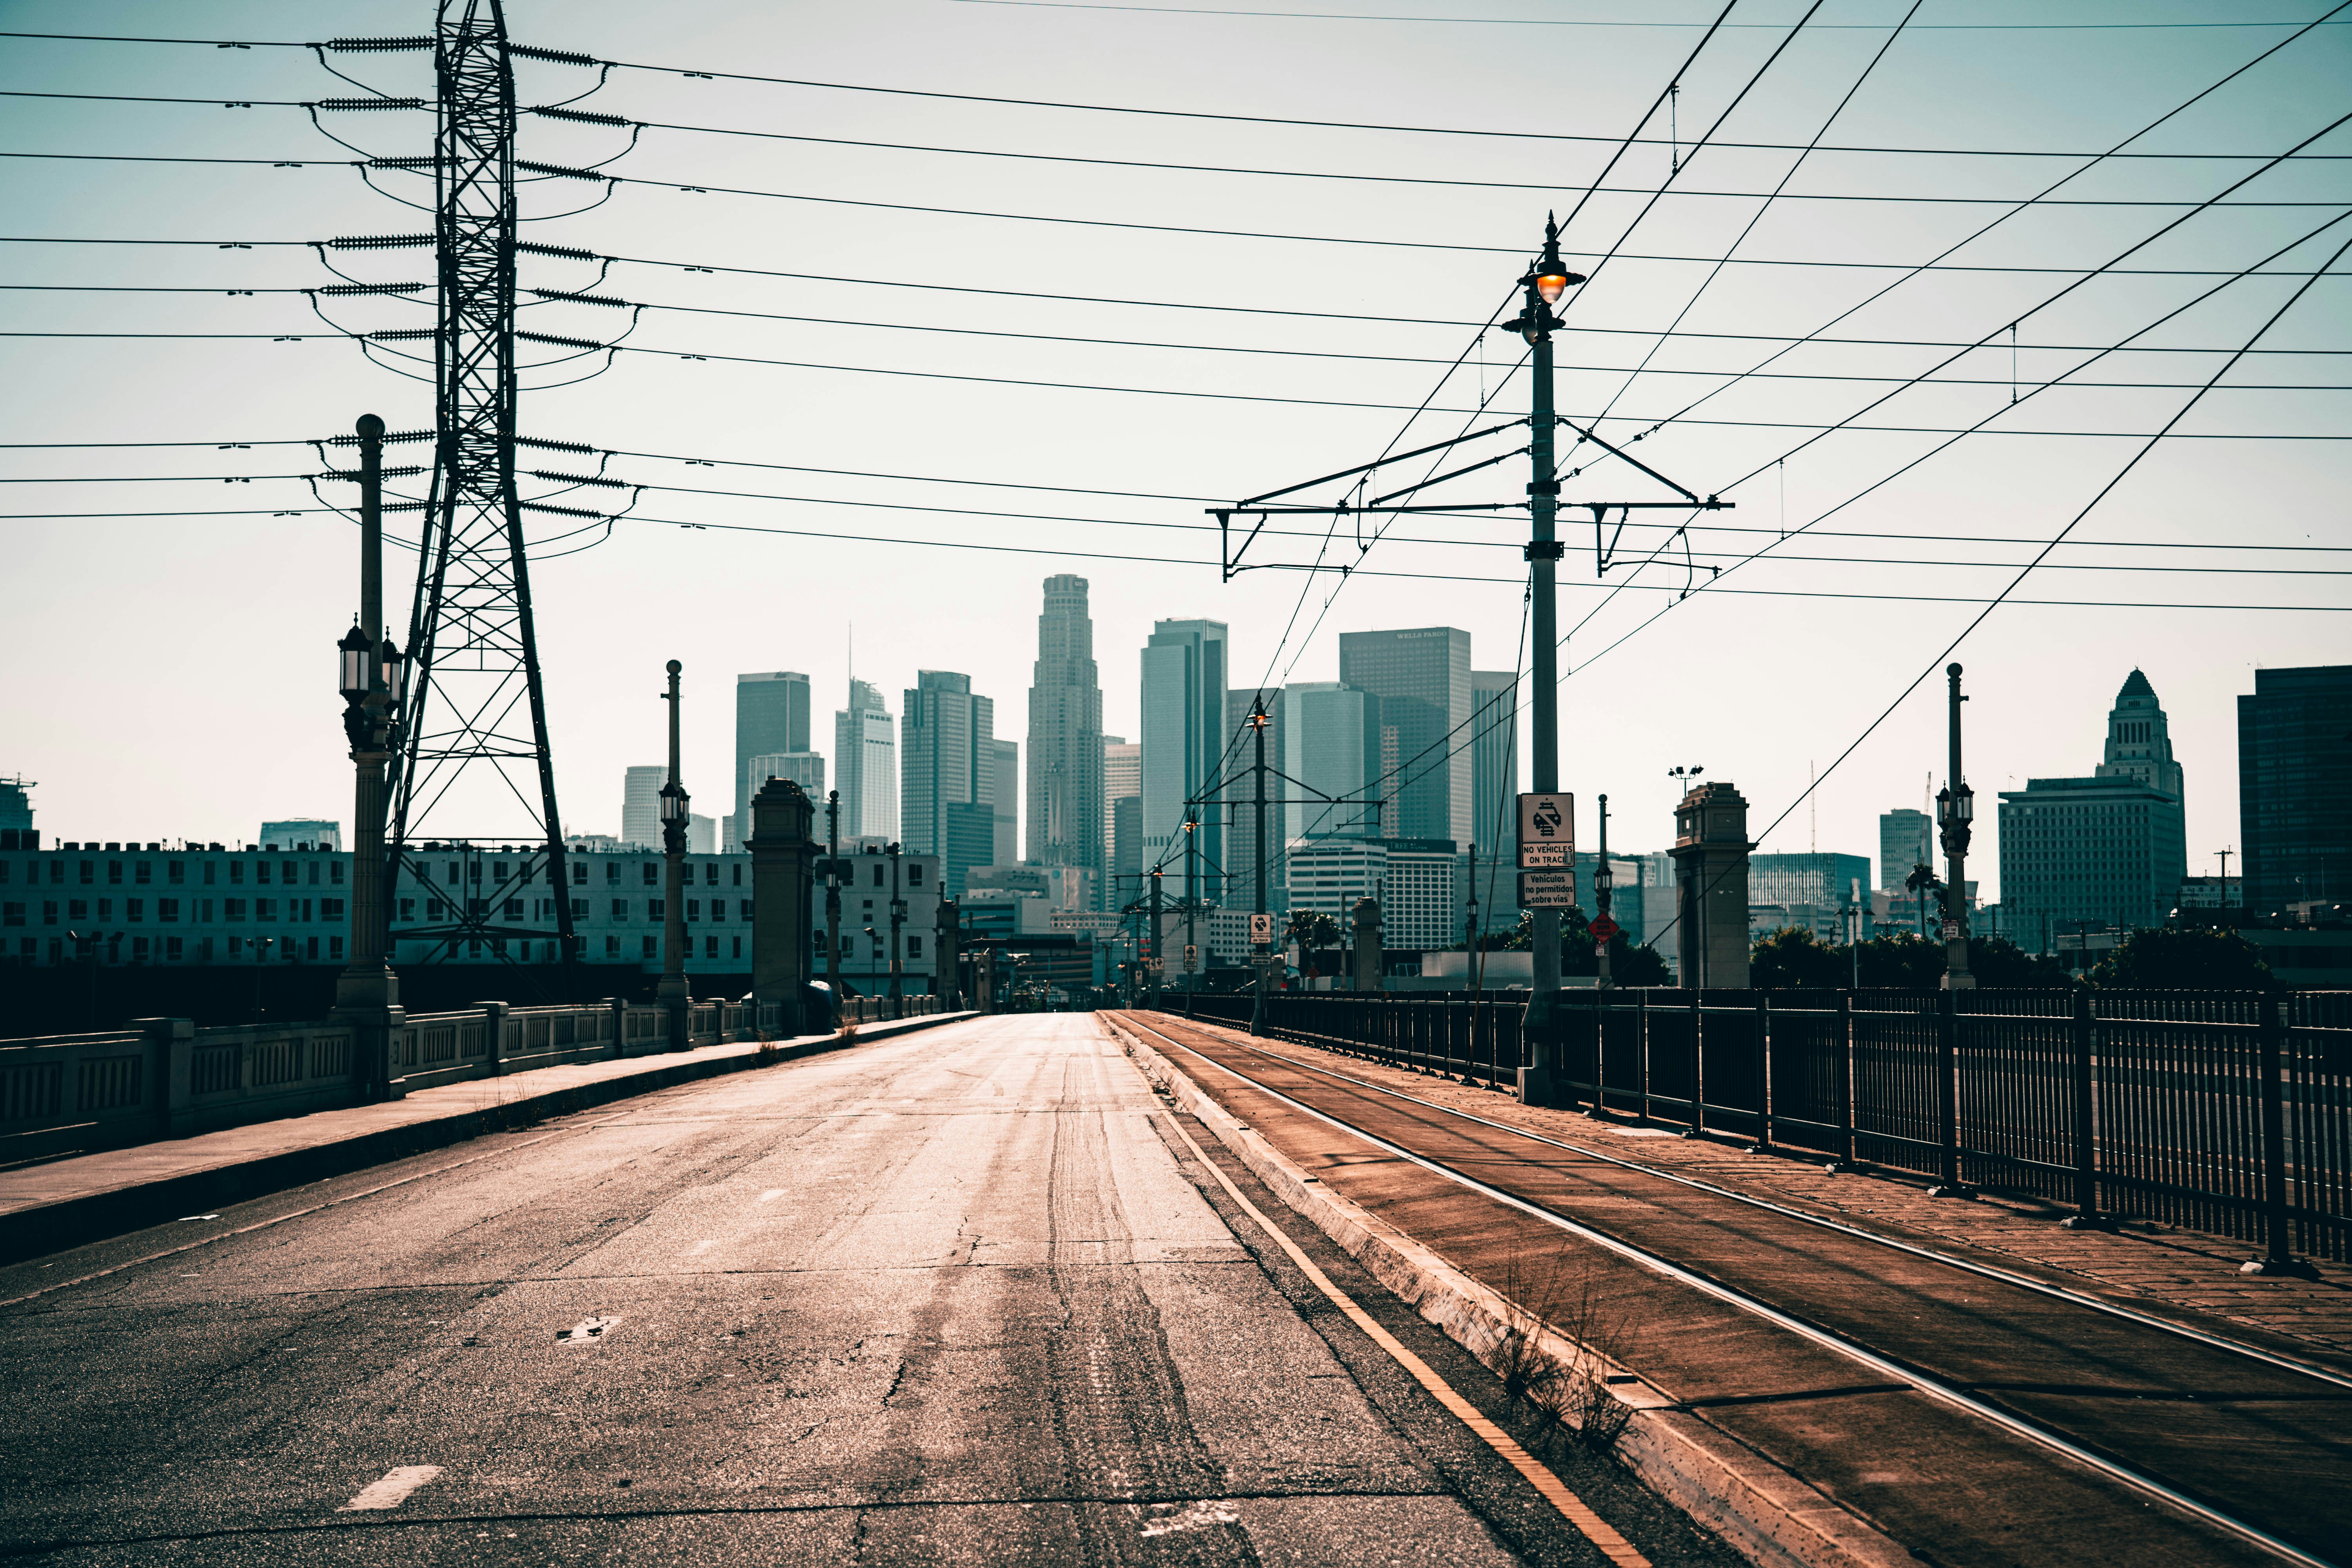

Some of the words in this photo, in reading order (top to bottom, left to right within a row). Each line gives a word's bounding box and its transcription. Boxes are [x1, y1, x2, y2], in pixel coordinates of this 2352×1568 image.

[1531, 875, 1565, 883] Vehículos
[1536, 885, 1573, 895] permitidos
[1553, 895, 1568, 903] vías
